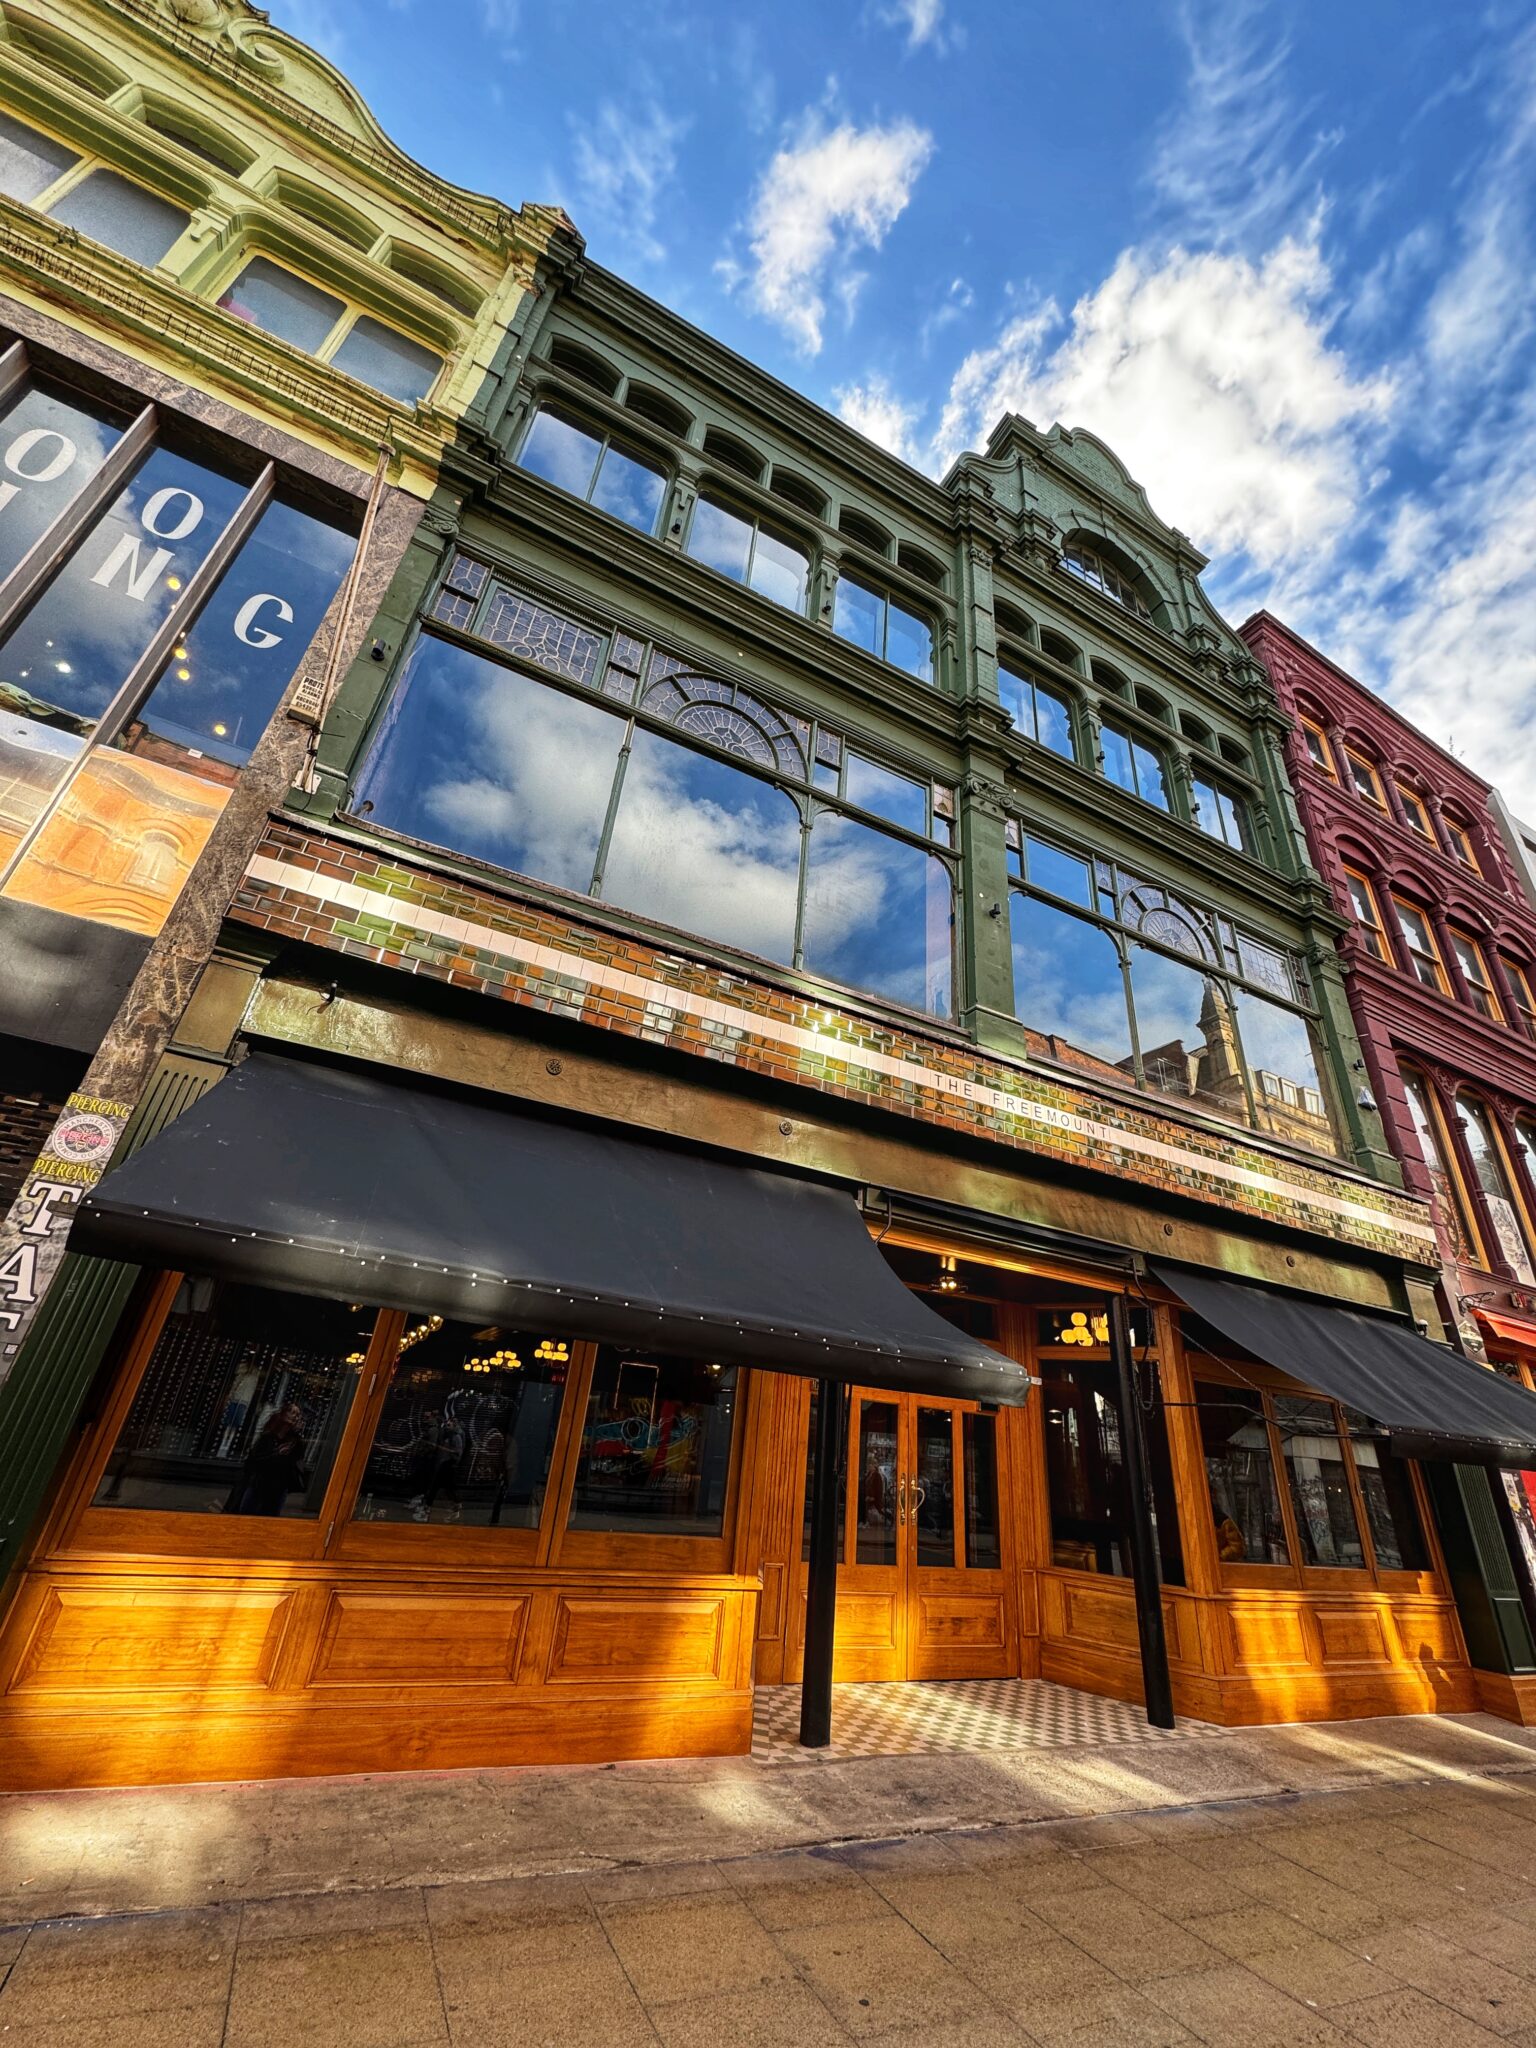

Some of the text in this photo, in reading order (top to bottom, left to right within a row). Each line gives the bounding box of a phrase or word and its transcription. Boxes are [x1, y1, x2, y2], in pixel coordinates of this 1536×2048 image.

[66, 1094, 132, 1118] PIERCING
[934, 1073, 1108, 1139] THE FREEMOUNT
[31, 1159, 101, 1183] PIERCING
